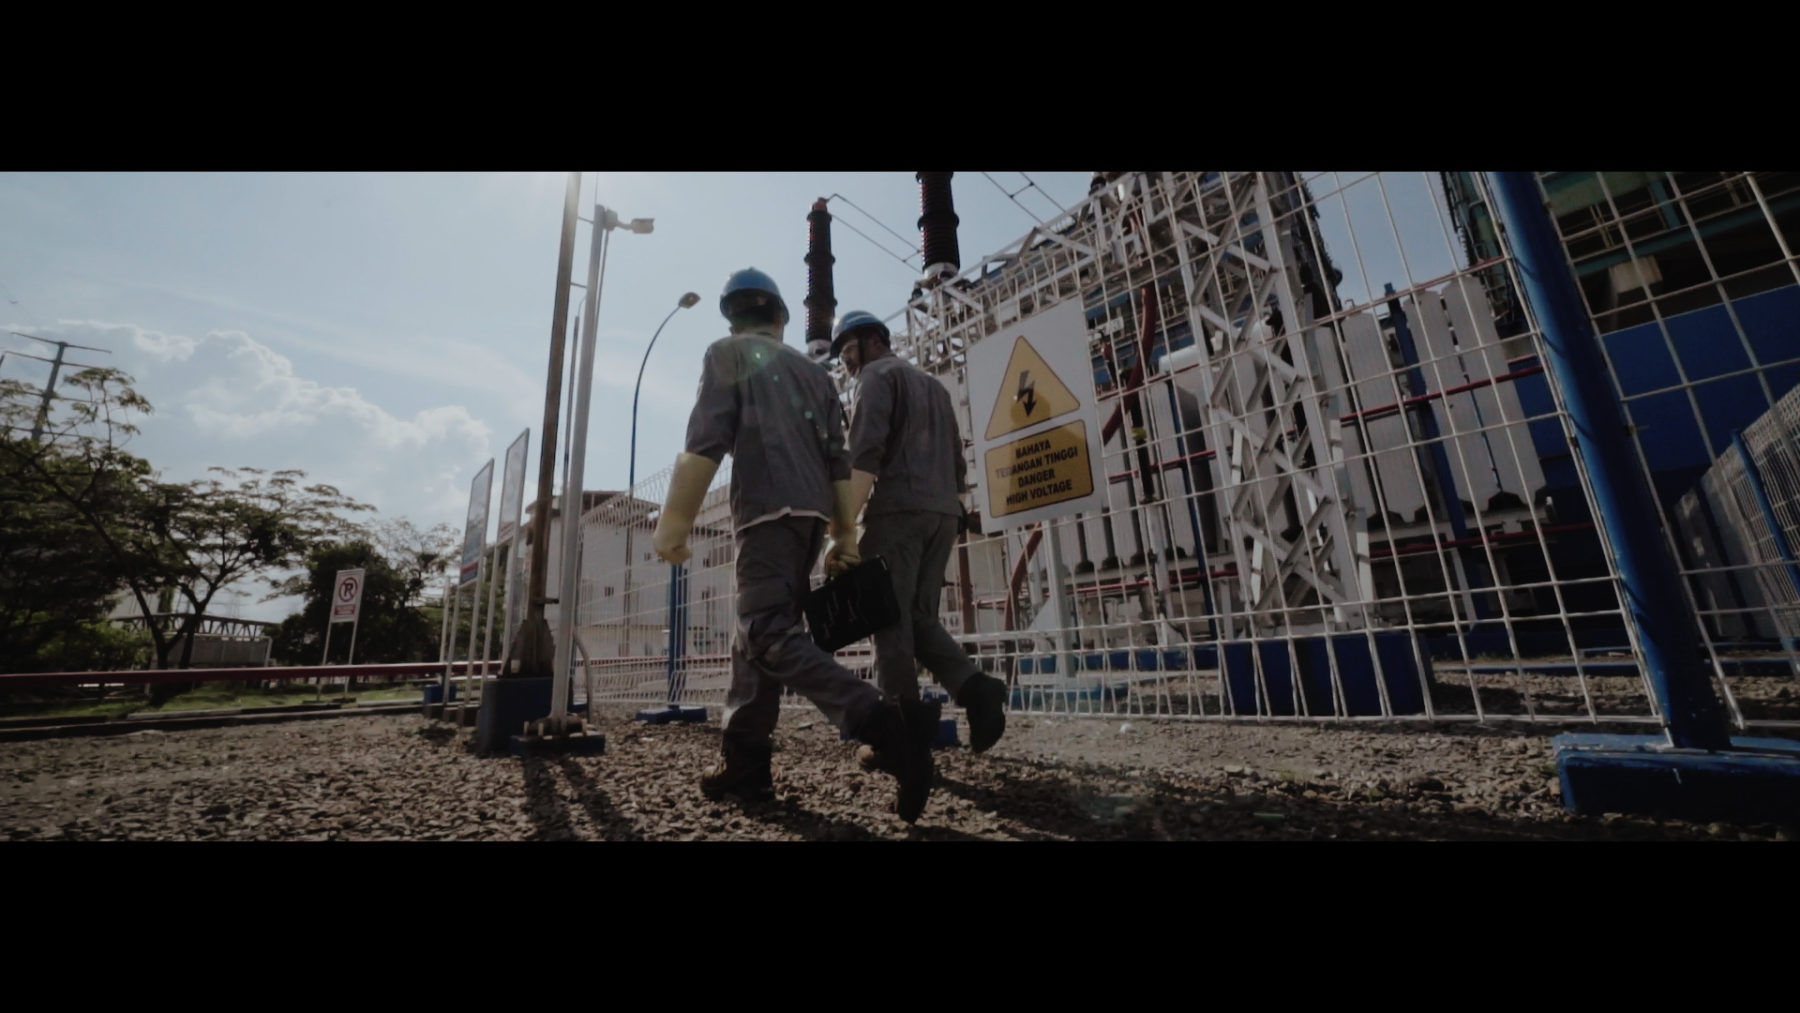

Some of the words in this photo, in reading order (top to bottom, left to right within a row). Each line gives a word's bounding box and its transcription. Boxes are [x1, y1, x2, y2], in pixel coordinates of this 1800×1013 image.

[1015, 439, 1051, 459] BAHAYA
[1044, 446, 1078, 465] TINGGI
[1018, 468, 1056, 488] DANGER
[1006, 490, 1028, 505] HIGH
[1029, 479, 1073, 499] VOLTAGE
